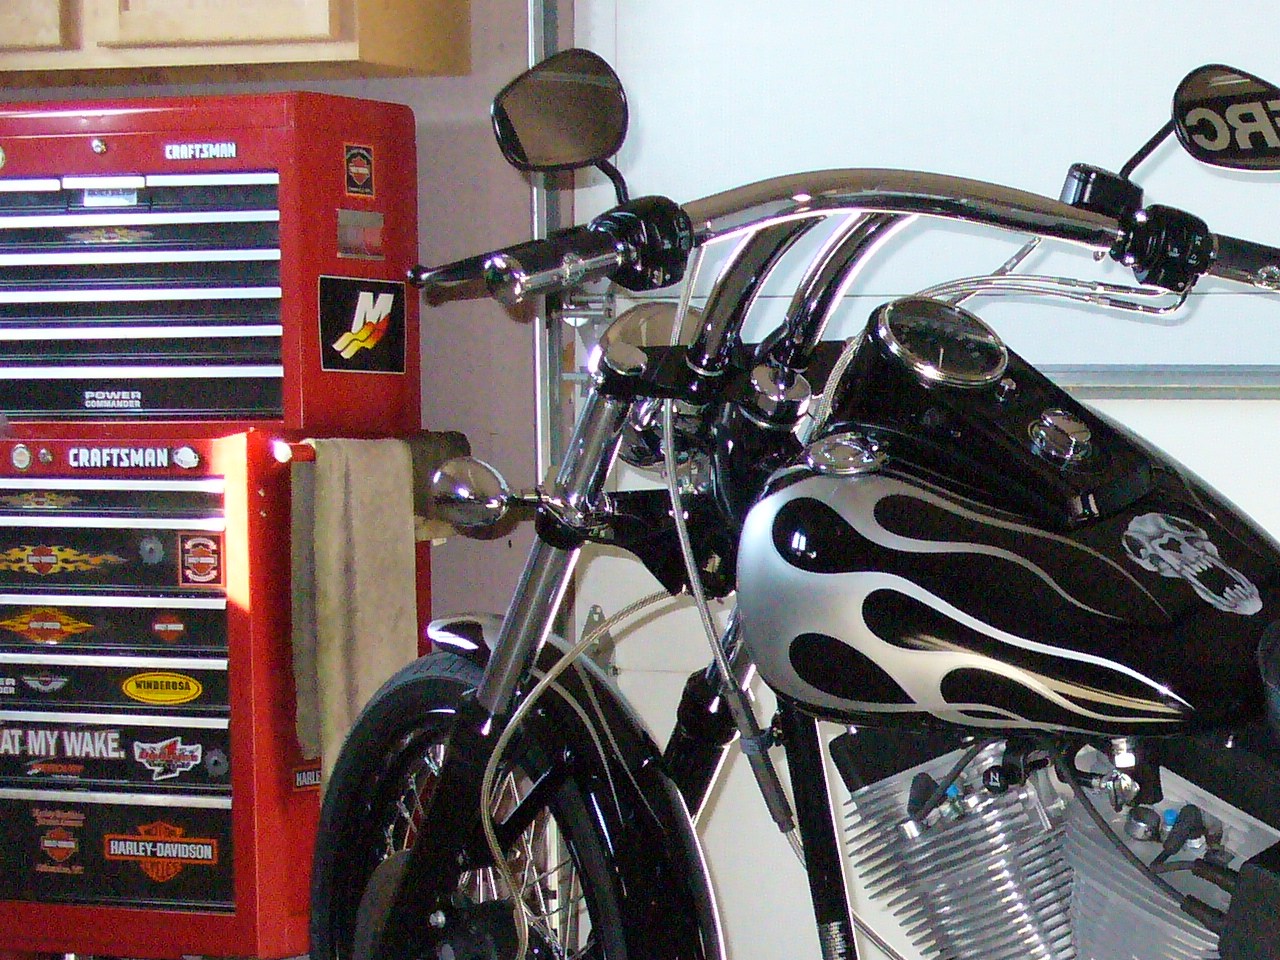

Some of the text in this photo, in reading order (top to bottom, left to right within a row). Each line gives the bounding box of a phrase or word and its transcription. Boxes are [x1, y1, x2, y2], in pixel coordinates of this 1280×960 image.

[165, 142, 236, 159] CRAFTSMAN
[85, 391, 141, 400] POWER
[85, 400, 141, 408] COMMANDER
[69, 448, 168, 468] CRAFTSMAN
[135, 680, 191, 690] WINDEROSA
[28, 730, 58, 756] MY
[63, 731, 125, 758] WAKE.
[110, 840, 212, 859] HARLEY-DAVIDSON
